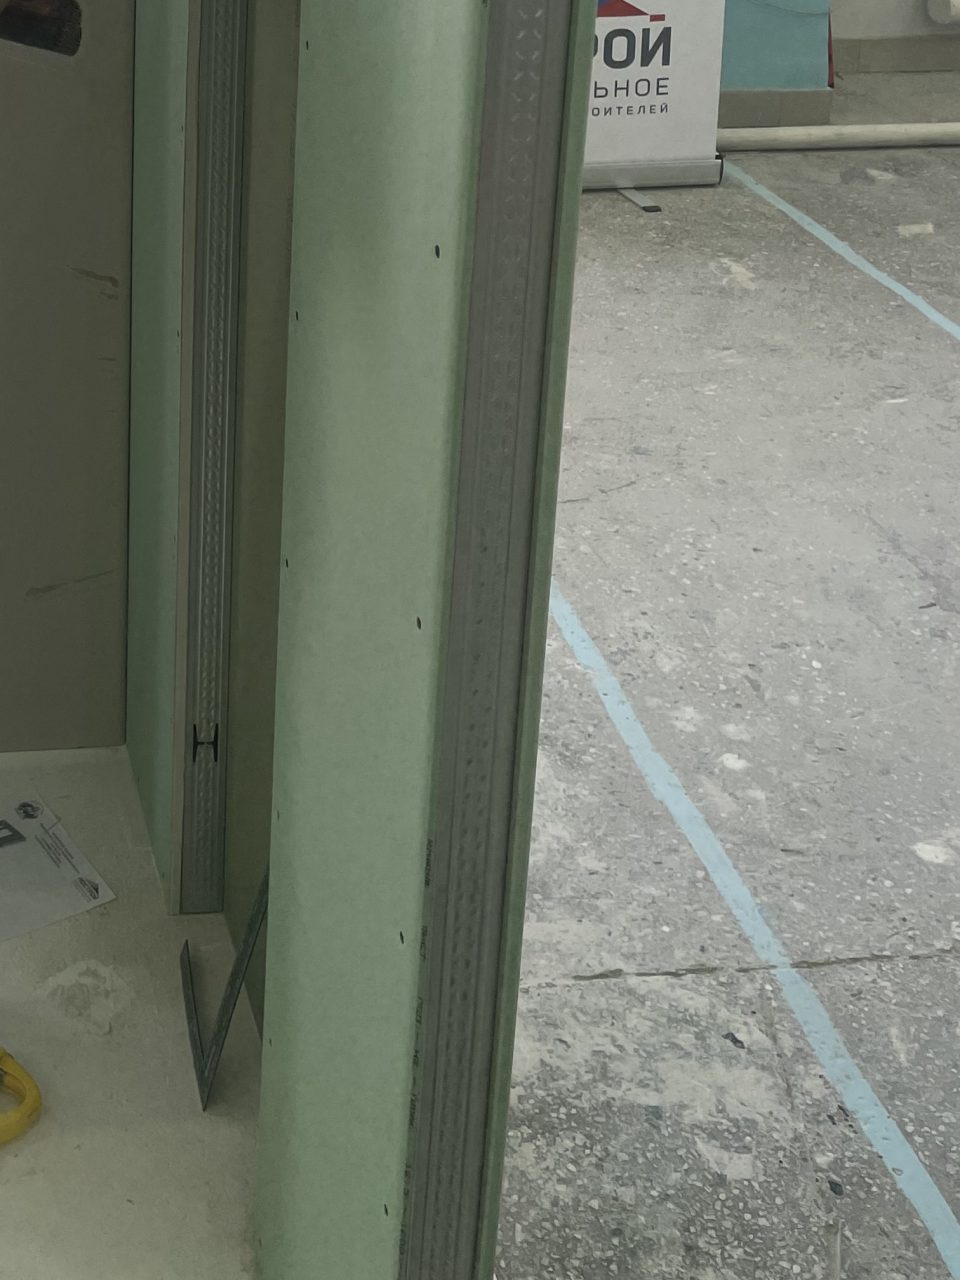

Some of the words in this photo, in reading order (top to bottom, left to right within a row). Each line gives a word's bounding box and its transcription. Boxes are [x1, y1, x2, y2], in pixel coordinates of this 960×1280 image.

[594, 27, 672, 69] ОЙ
[593, 77, 669, 98] ЬНОЕ
[591, 103, 668, 117] ОИТЕЛЕЙ
